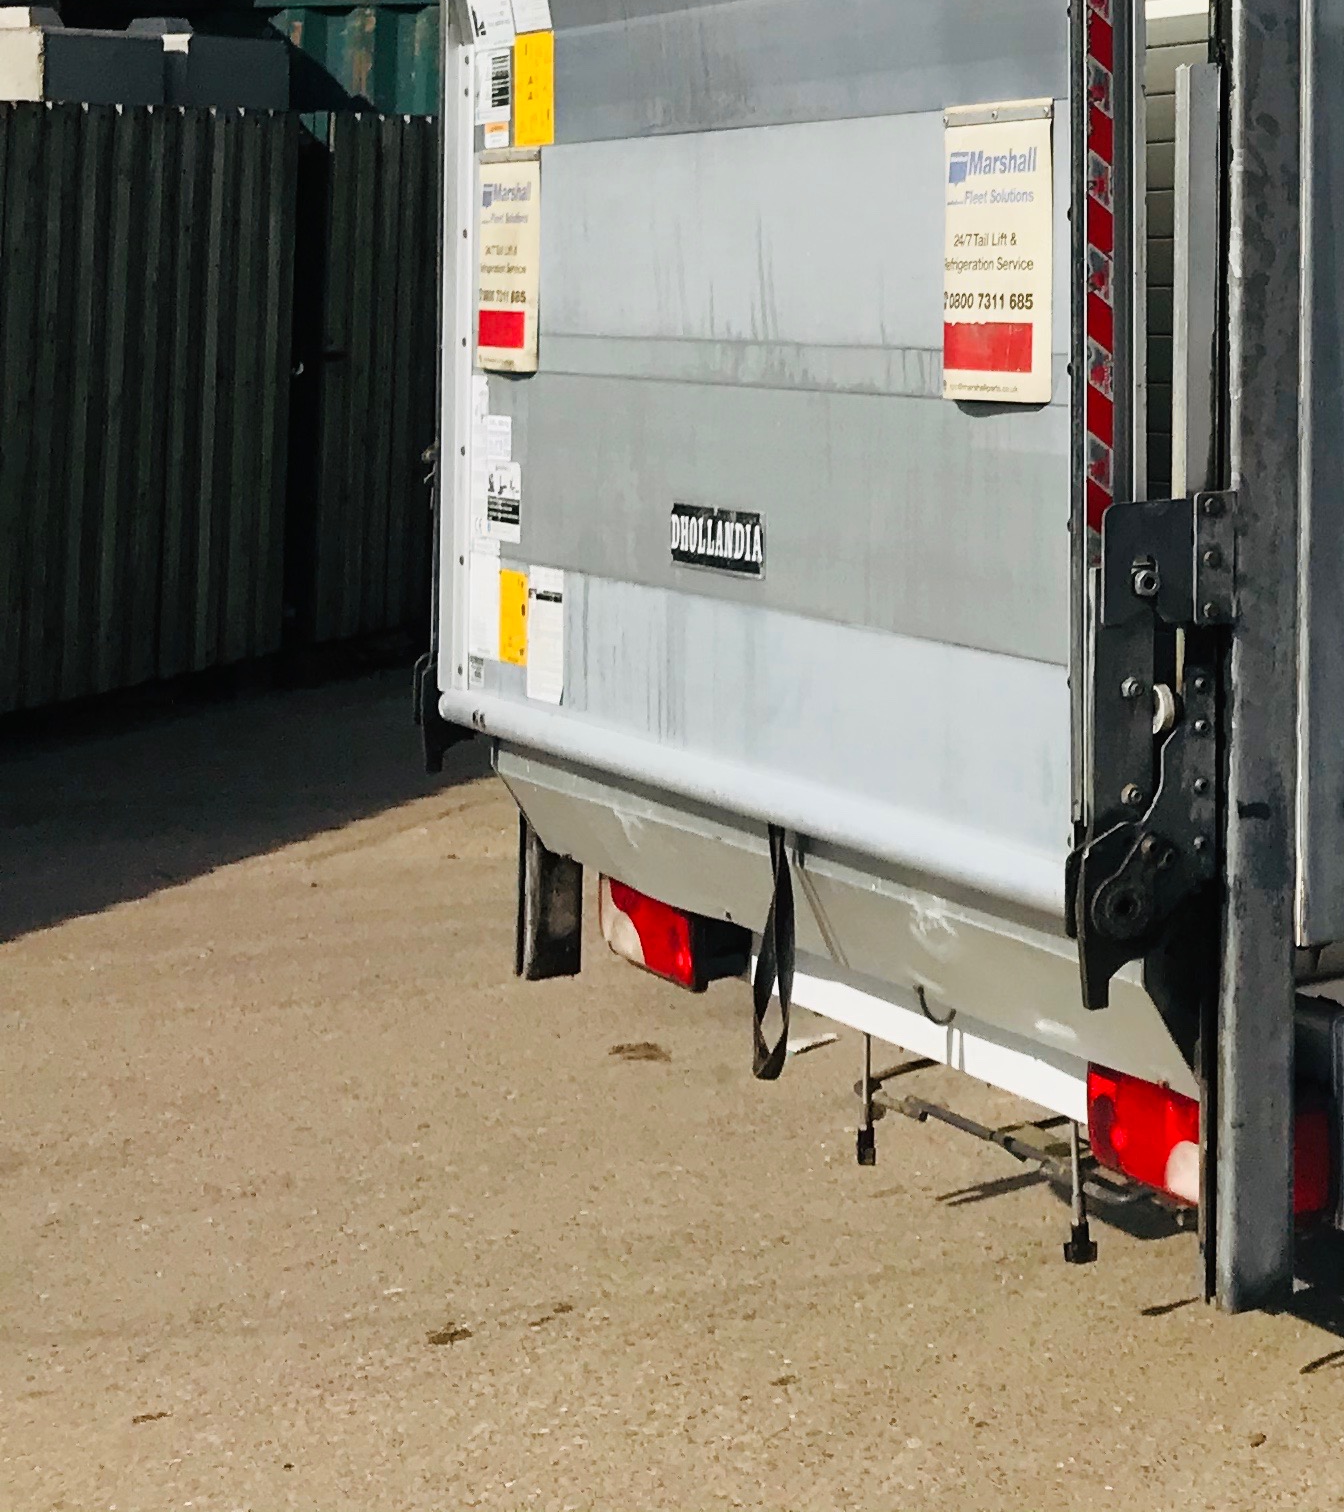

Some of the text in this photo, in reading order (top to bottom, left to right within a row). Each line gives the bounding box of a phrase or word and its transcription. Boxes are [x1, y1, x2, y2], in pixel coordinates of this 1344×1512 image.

[967, 146, 1038, 176] Marshall
[964, 189, 988, 206] Fleet
[989, 188, 1035, 204] Solutions
[953, 231, 1018, 248] 24/7 Tail Lift &
[996, 255, 1034, 271] Service
[948, 291, 1034, 311] 0800 7311 685
[670, 512, 764, 565] DHOLLANDIA
